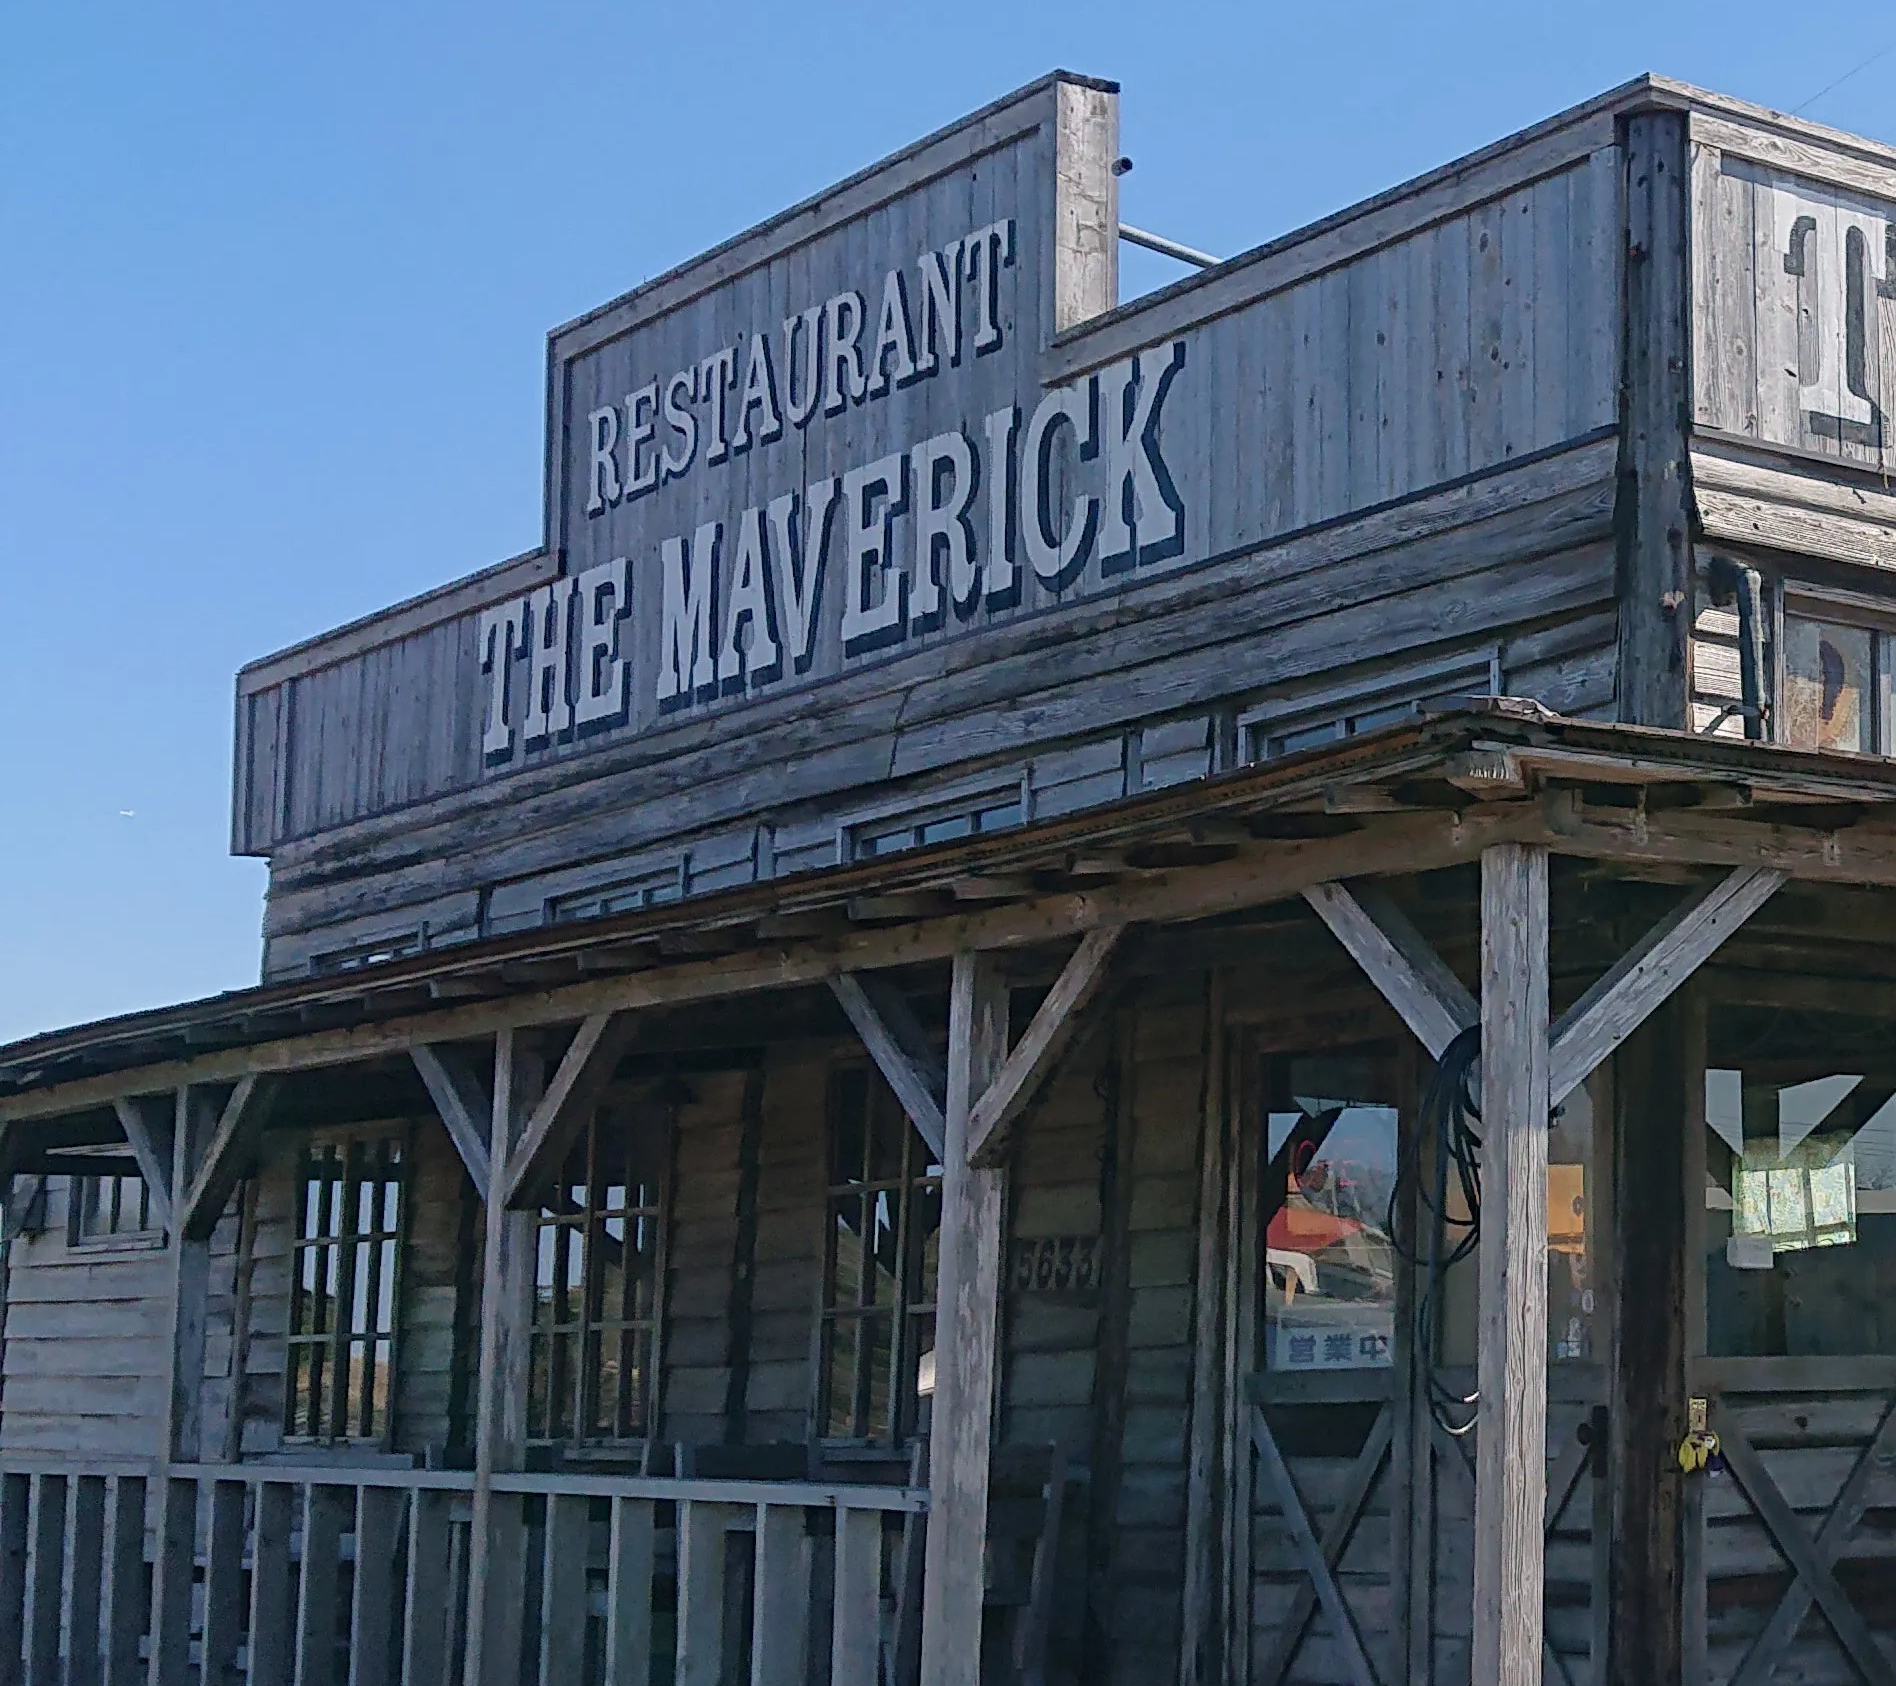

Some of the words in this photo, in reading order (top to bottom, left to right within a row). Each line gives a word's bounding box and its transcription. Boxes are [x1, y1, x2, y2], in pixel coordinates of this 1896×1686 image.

[586, 219, 1015, 520] RESTAURANT
[479, 555, 632, 768] THE
[657, 341, 1185, 712] MAVERICK
[1288, 1333, 1389, 1363] 営業中
